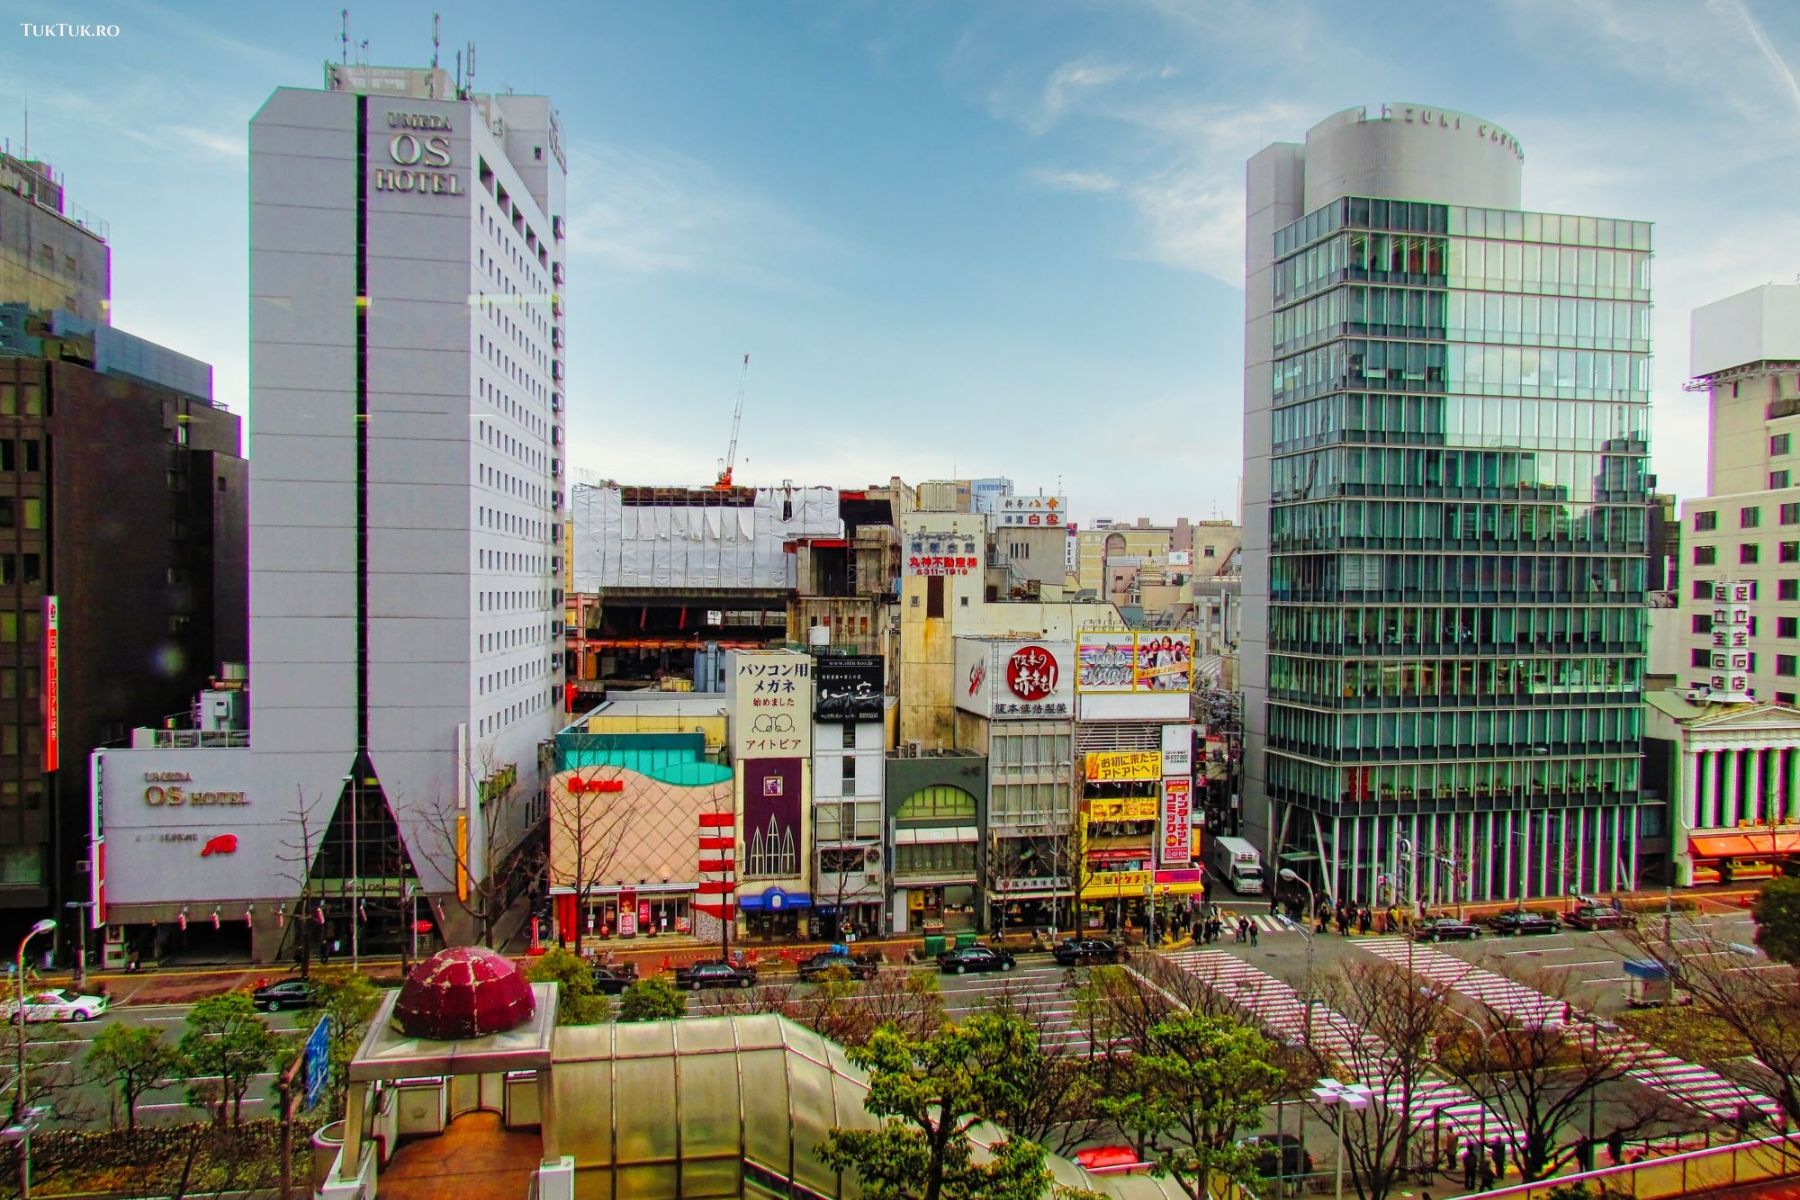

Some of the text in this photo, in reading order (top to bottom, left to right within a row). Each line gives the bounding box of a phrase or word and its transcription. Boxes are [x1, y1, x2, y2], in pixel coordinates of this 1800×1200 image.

[388, 111, 453, 132] UMEDA
[389, 132, 451, 168] OS
[375, 168, 465, 196] HOTEL
[739, 663, 808, 677] パソコン用
[753, 679, 796, 694] メガネ
[752, 697, 795, 708] 始めました
[145, 785, 186, 808] OS
[1166, 793, 1177, 834] コミック
[1177, 792, 1188, 847] インターネット
